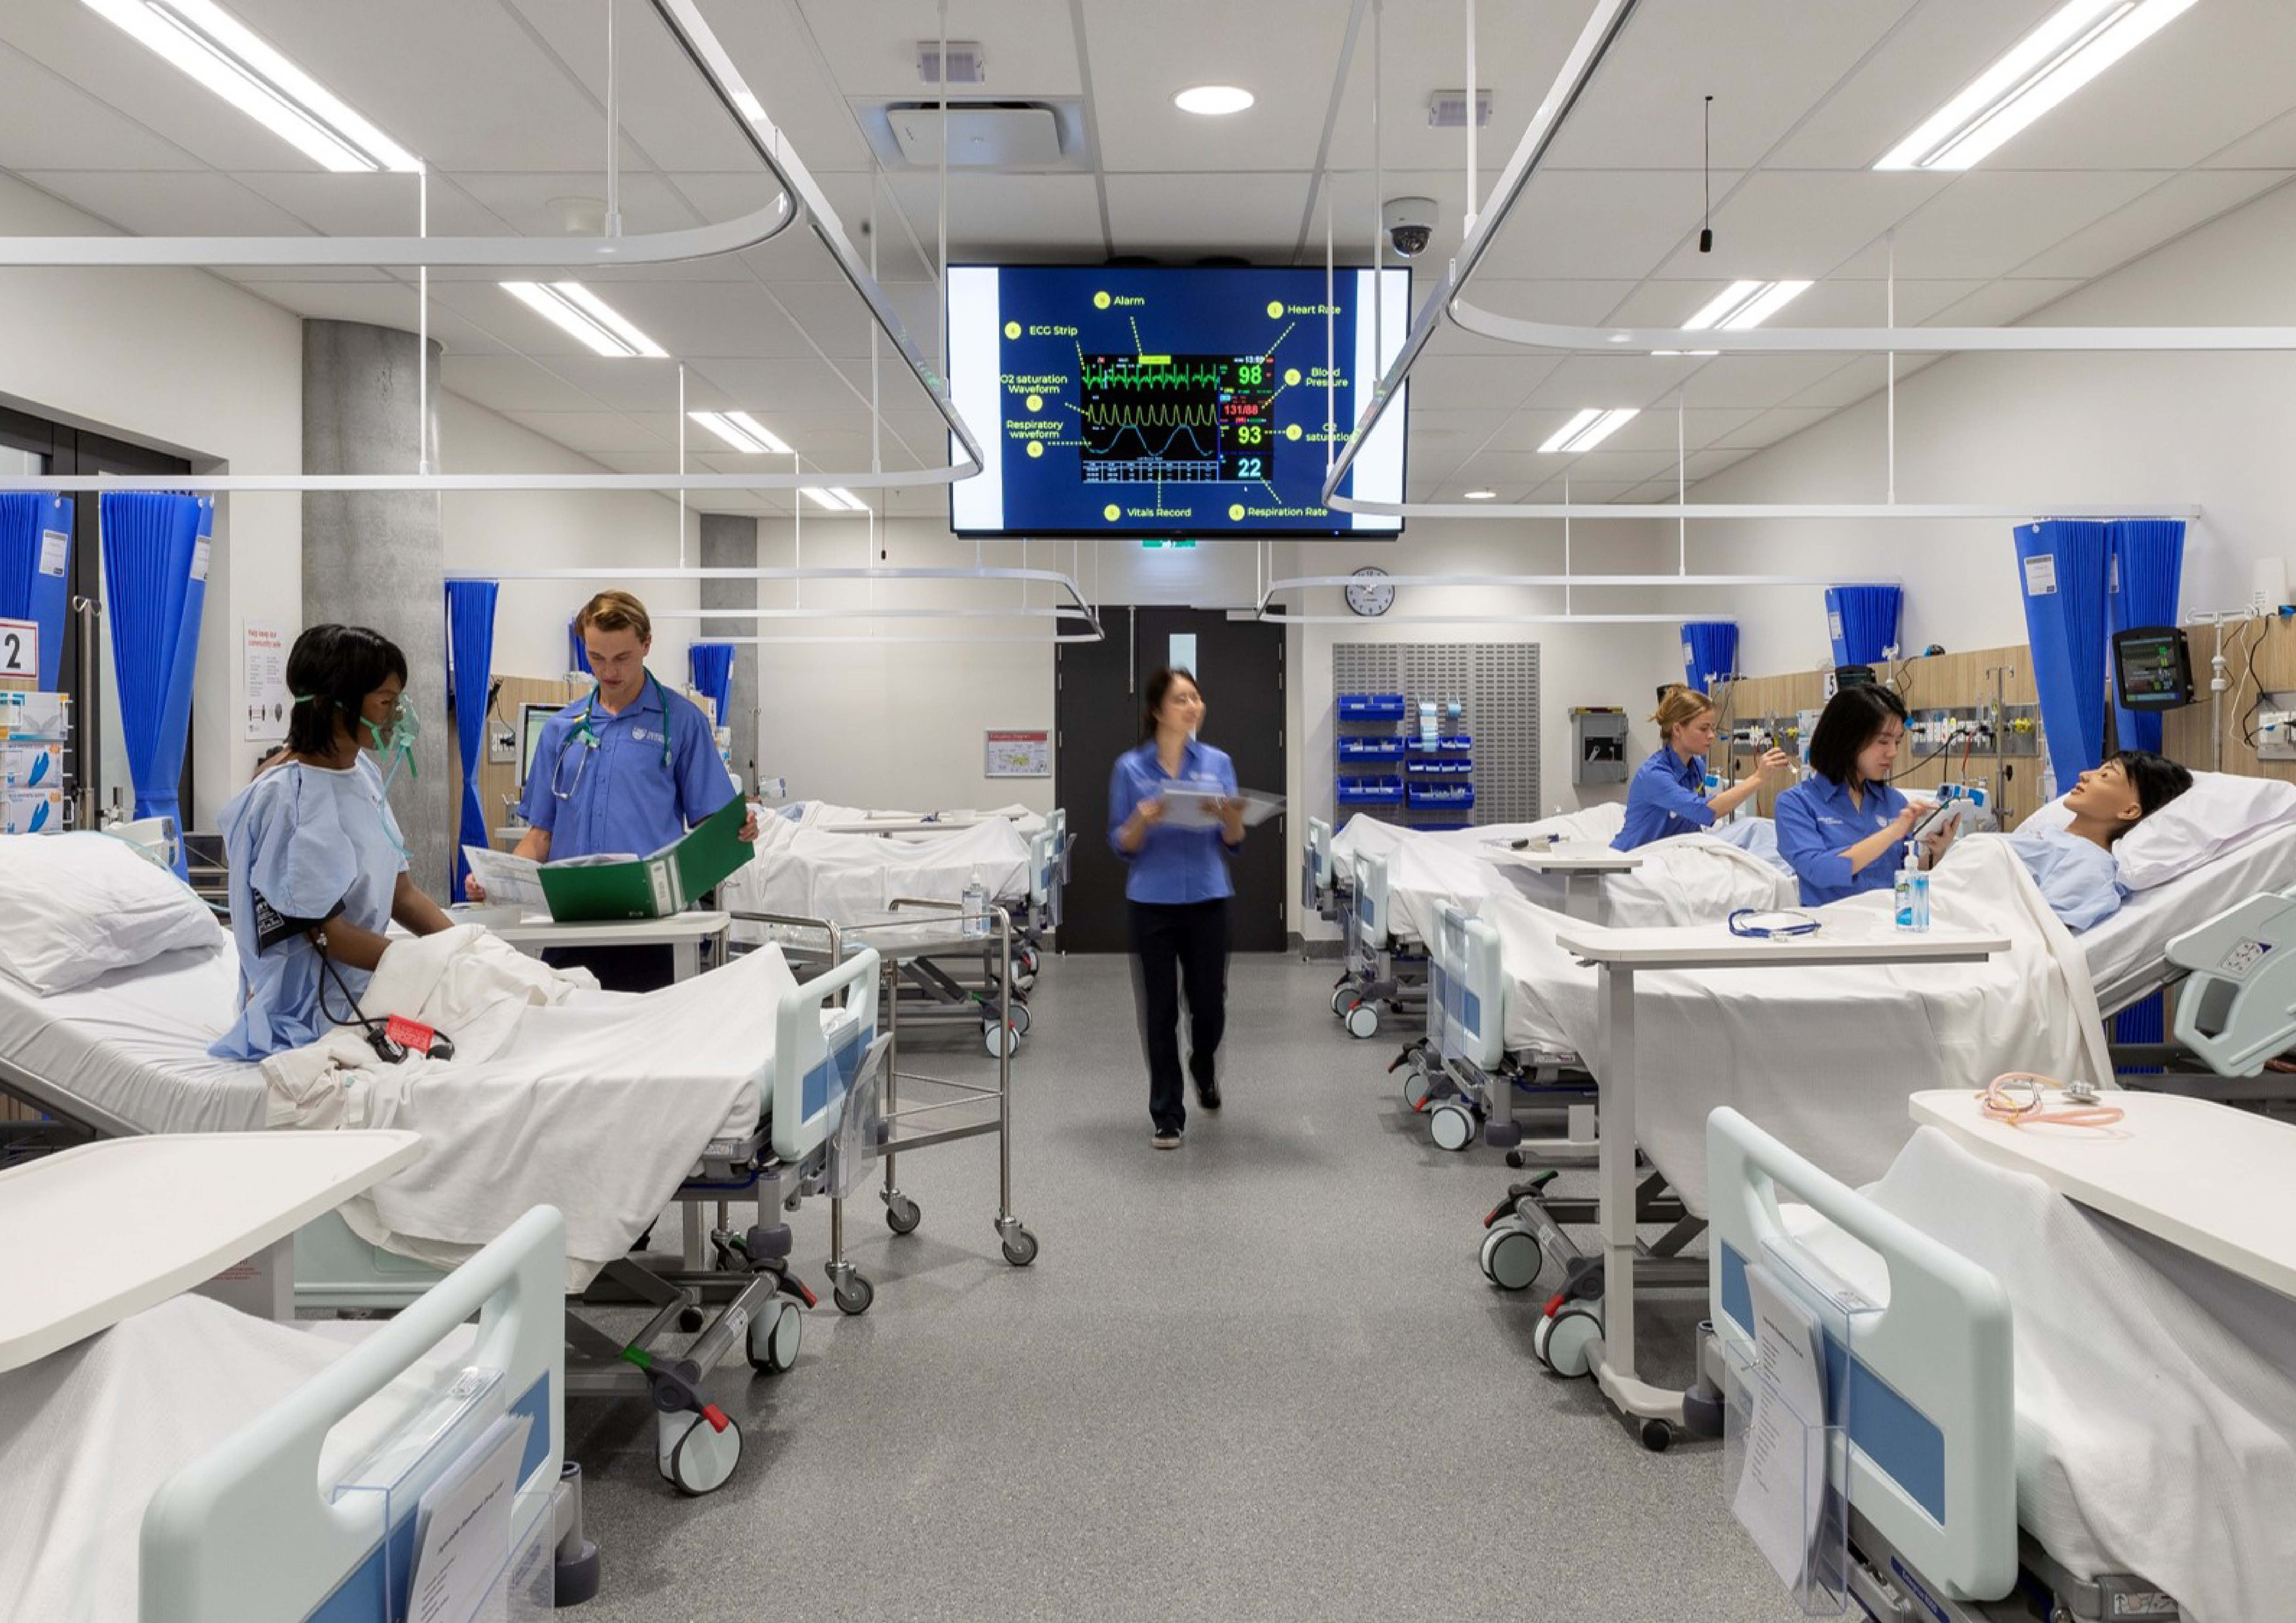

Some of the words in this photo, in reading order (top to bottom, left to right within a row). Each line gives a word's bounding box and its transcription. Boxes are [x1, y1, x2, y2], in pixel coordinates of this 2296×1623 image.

[1114, 296, 1145, 306] Alarm
[1287, 304, 1316, 314] Heart
[1029, 325, 1051, 335] ECG
[1053, 325, 1078, 337] Strip
[1000, 374, 1014, 384] O2
[1016, 374, 1067, 384] saturation
[1238, 365, 1263, 385] 98
[1008, 383, 1060, 393] Waveform
[1007, 420, 1064, 431] Respiratory
[1009, 429, 1060, 439] waveform
[1237, 425, 1262, 445] 93
[1238, 459, 1261, 478] 22
[1128, 508, 1154, 518] Vitals
[1156, 508, 1192, 518] Record
[1248, 508, 1304, 519] Respiration
[1306, 508, 1328, 518] Rate
[5, 633, 21, 669] 2
